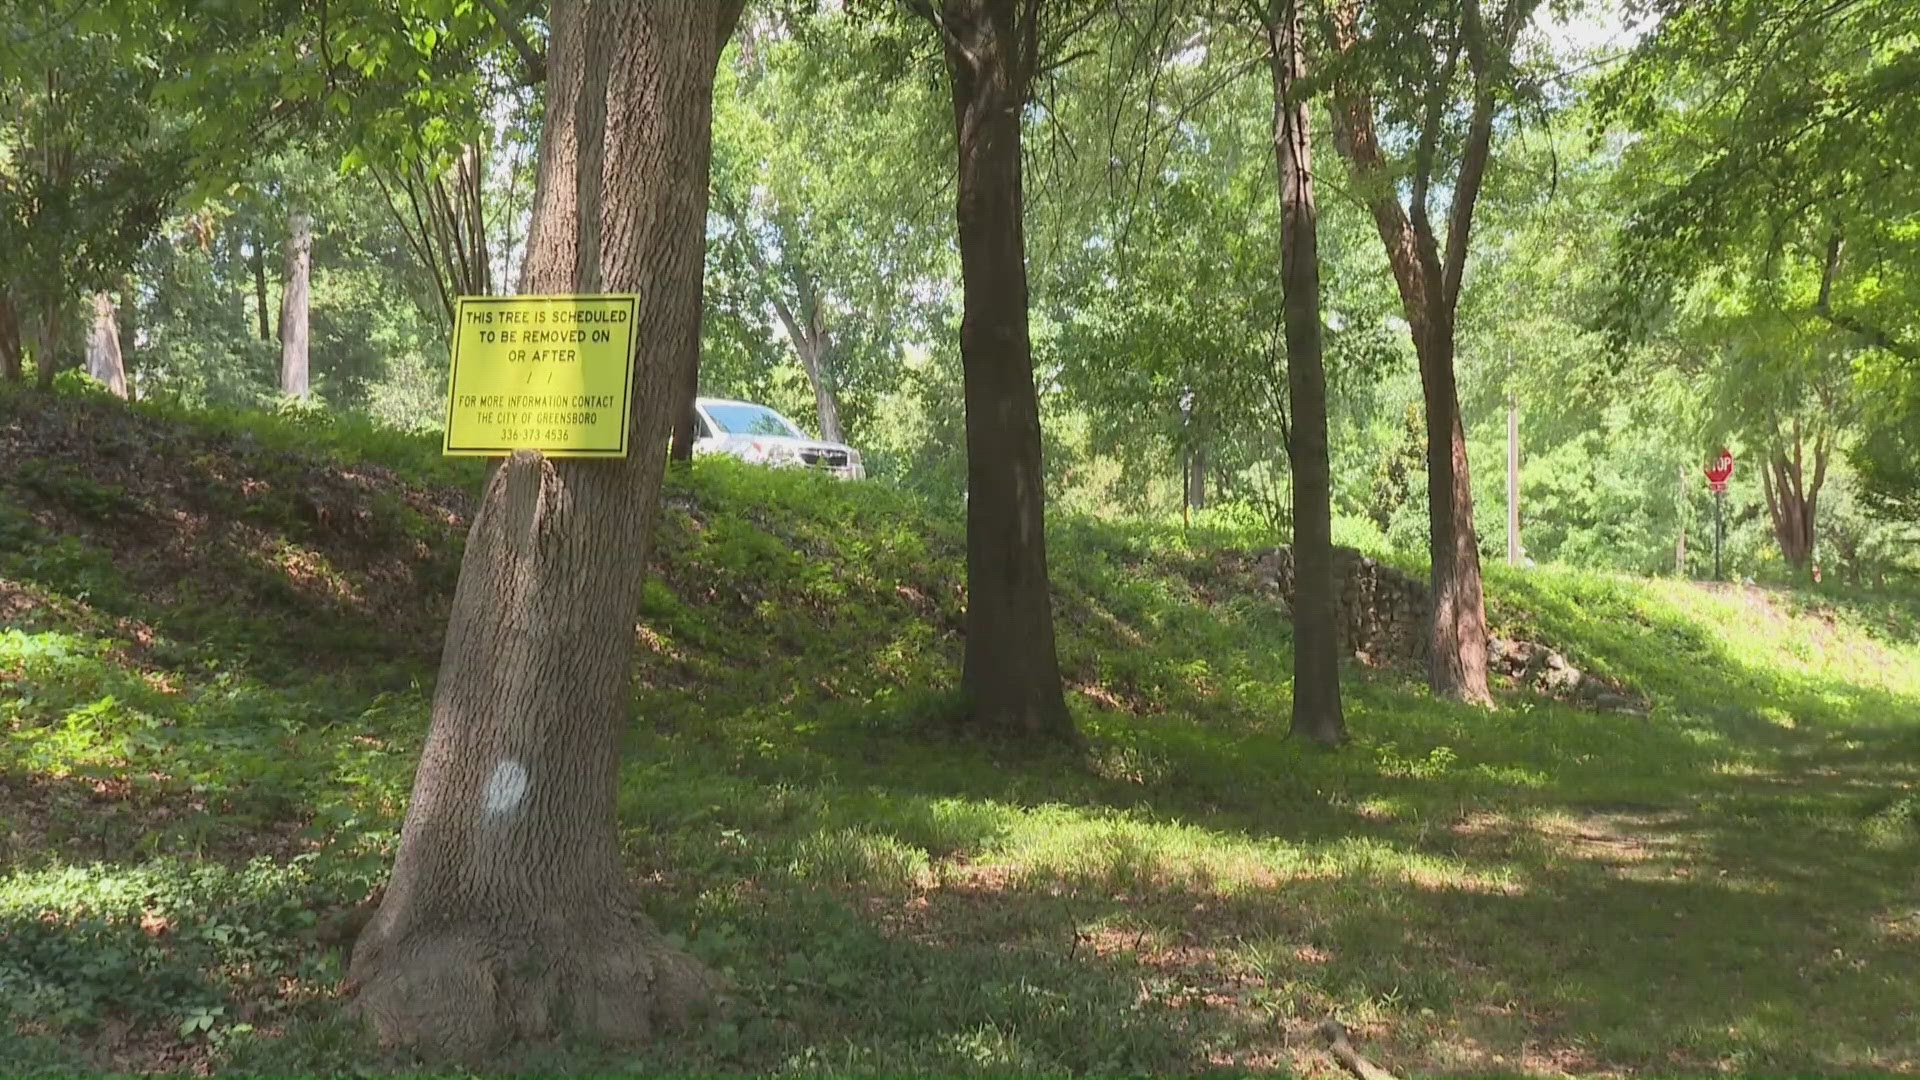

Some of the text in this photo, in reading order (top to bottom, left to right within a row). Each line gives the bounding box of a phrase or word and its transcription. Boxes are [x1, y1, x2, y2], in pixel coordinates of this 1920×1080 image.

[466, 310, 627, 324] THIS TREE IS SCHEDULED
[480, 329, 610, 343] TO BE REMOVED ON
[508, 349, 576, 362] OR AFTER
[459, 395, 614, 408] FOR MORE INFORMATION CONTACT
[477, 412, 597, 425] THE CITY OF GREENSBORO
